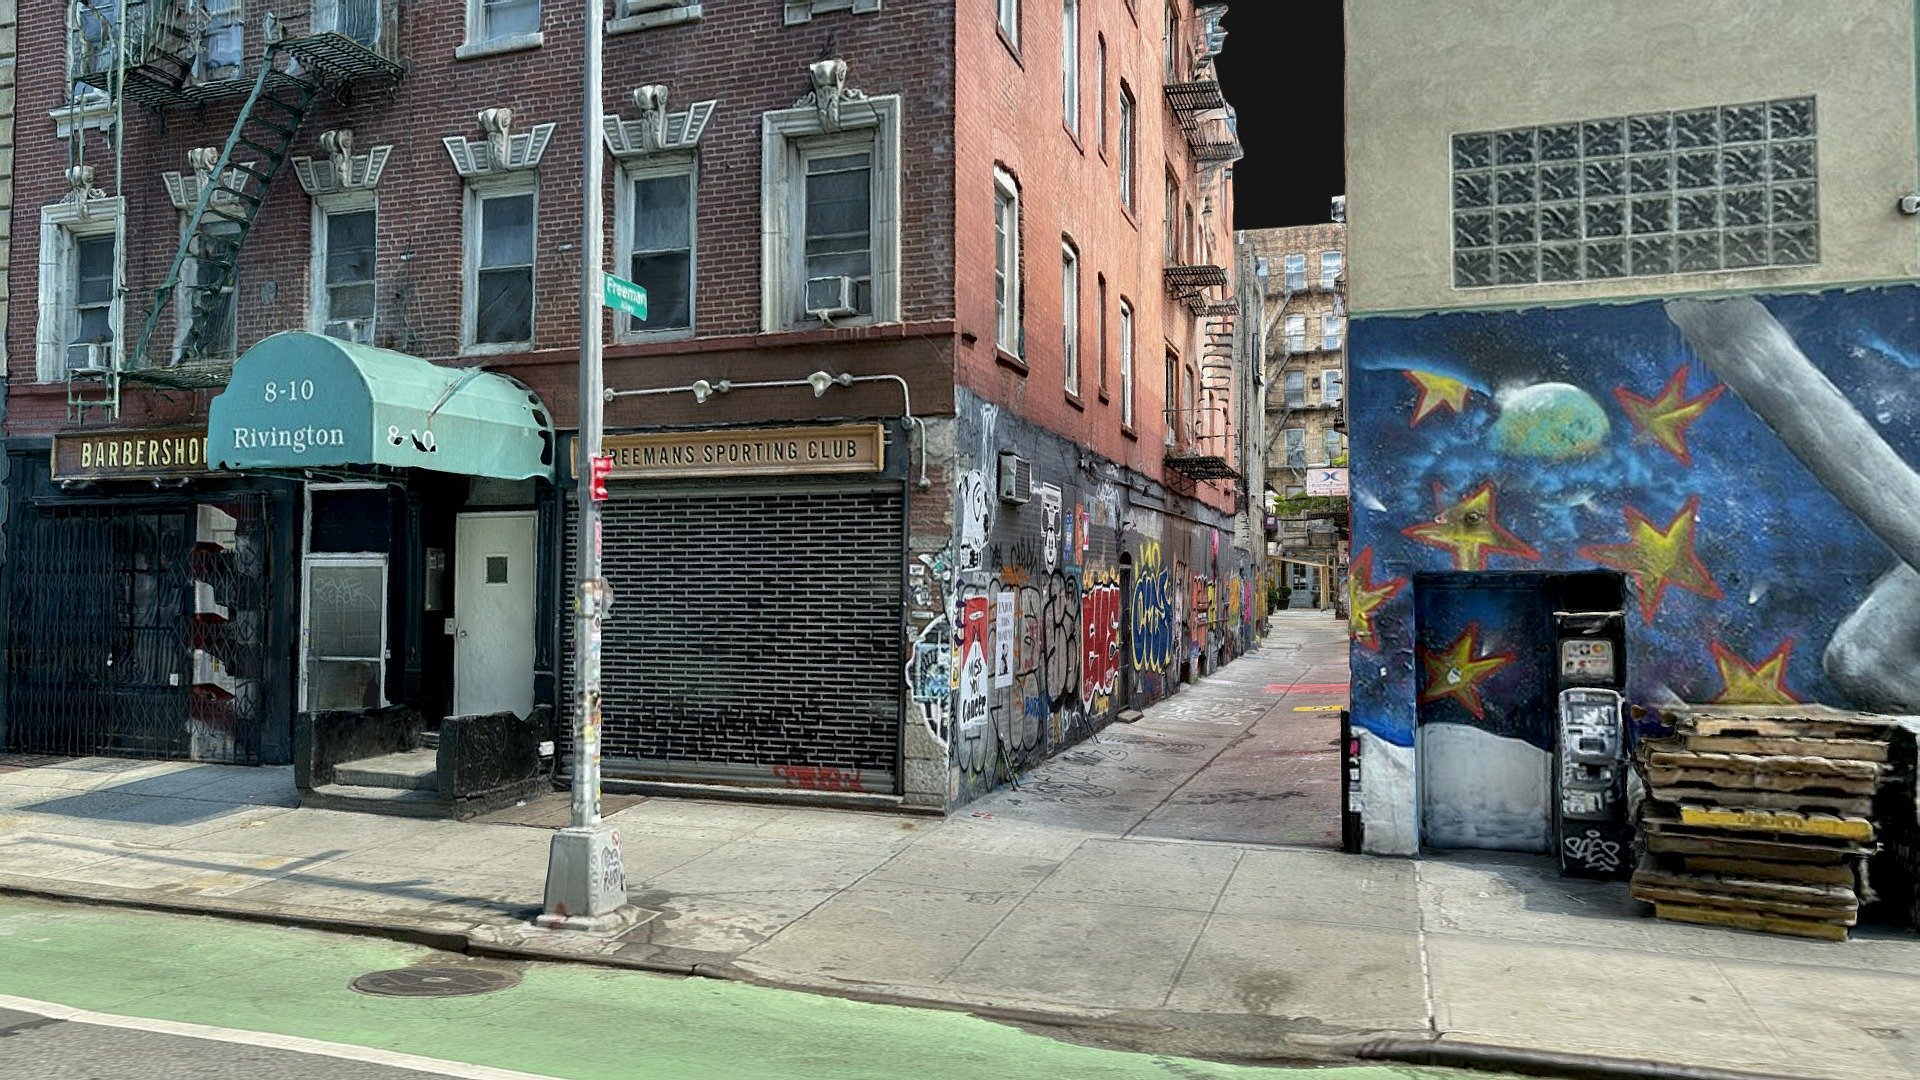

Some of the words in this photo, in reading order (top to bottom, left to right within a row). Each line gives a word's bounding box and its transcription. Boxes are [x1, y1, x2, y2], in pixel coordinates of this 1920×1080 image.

[264, 379, 314, 402] 8-10
[233, 425, 345, 453] Rivington
[703, 441, 798, 463] SPORTING
[807, 439, 857, 460] CLUB
